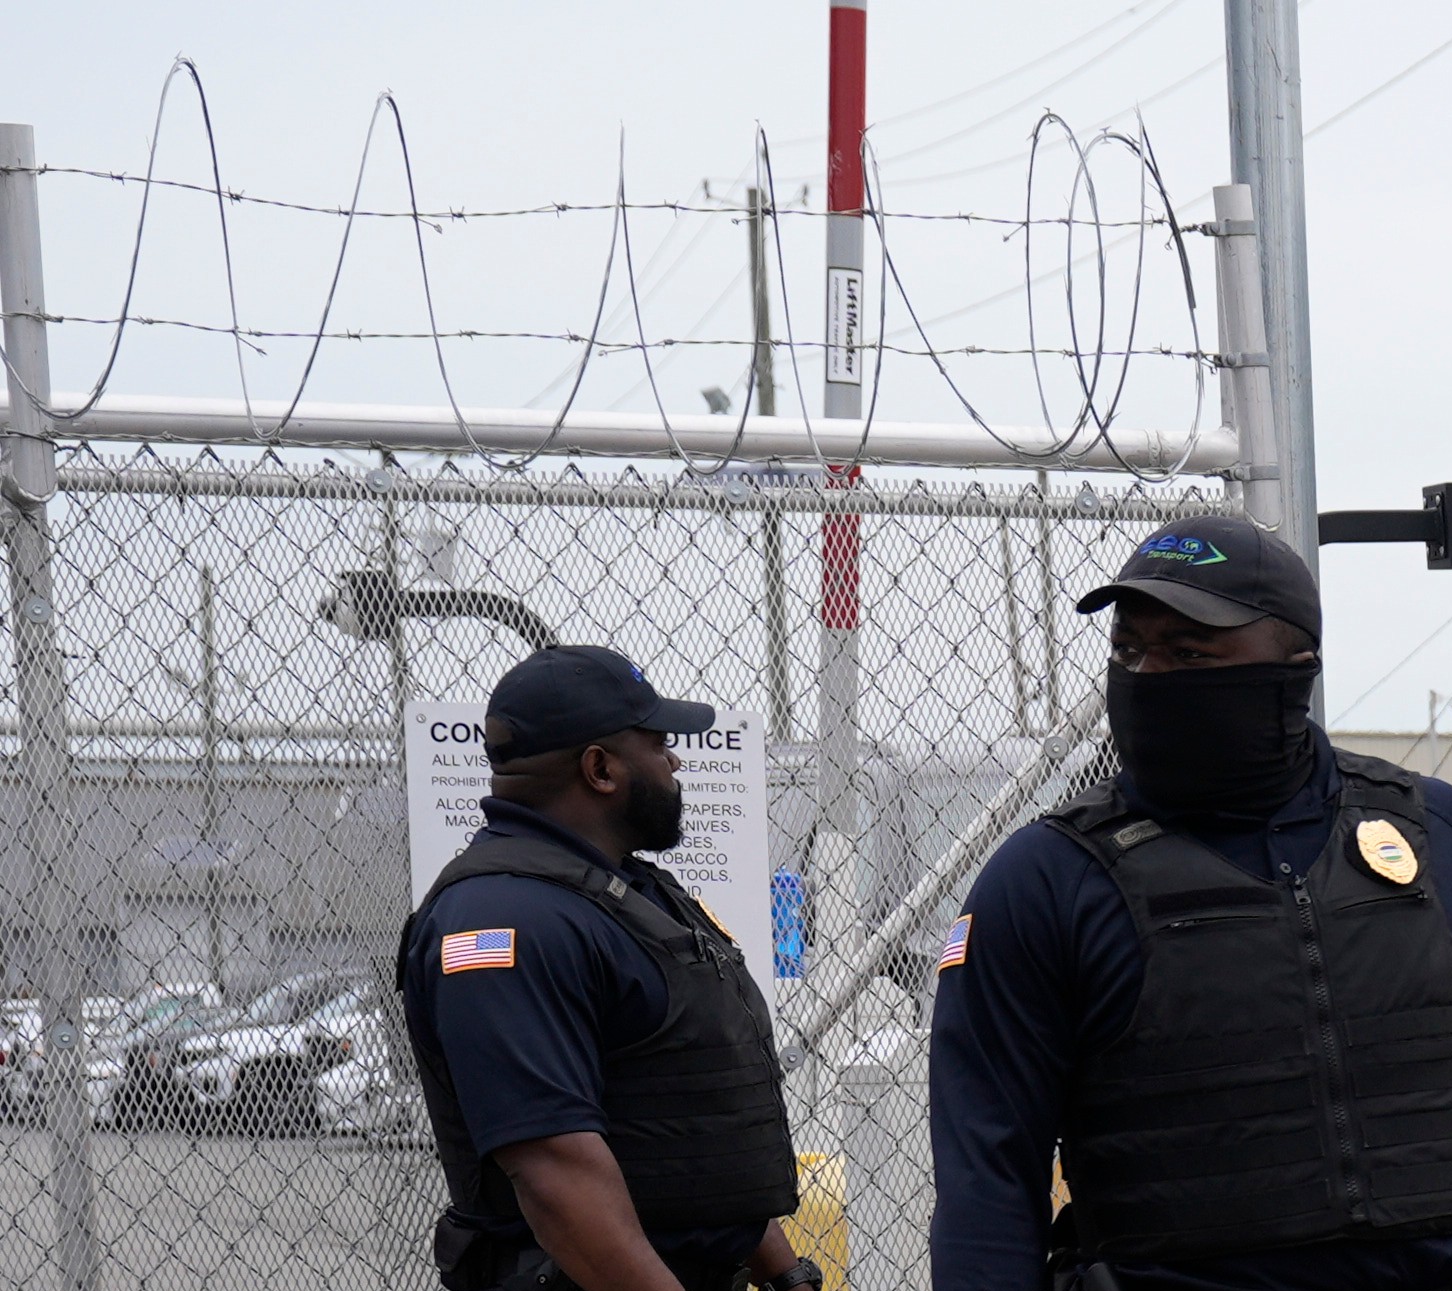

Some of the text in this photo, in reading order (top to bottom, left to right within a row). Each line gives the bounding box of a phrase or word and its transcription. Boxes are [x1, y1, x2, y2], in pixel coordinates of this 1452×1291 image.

[430, 722, 486, 743] CON
[432, 754, 742, 773] ALL VIS SEARCH
[681, 783, 727, 793] LIMITED
[682, 804, 746, 818] PAPERS,
[655, 853, 728, 865] TOBACCO
[678, 869, 733, 883] TOOLS,
